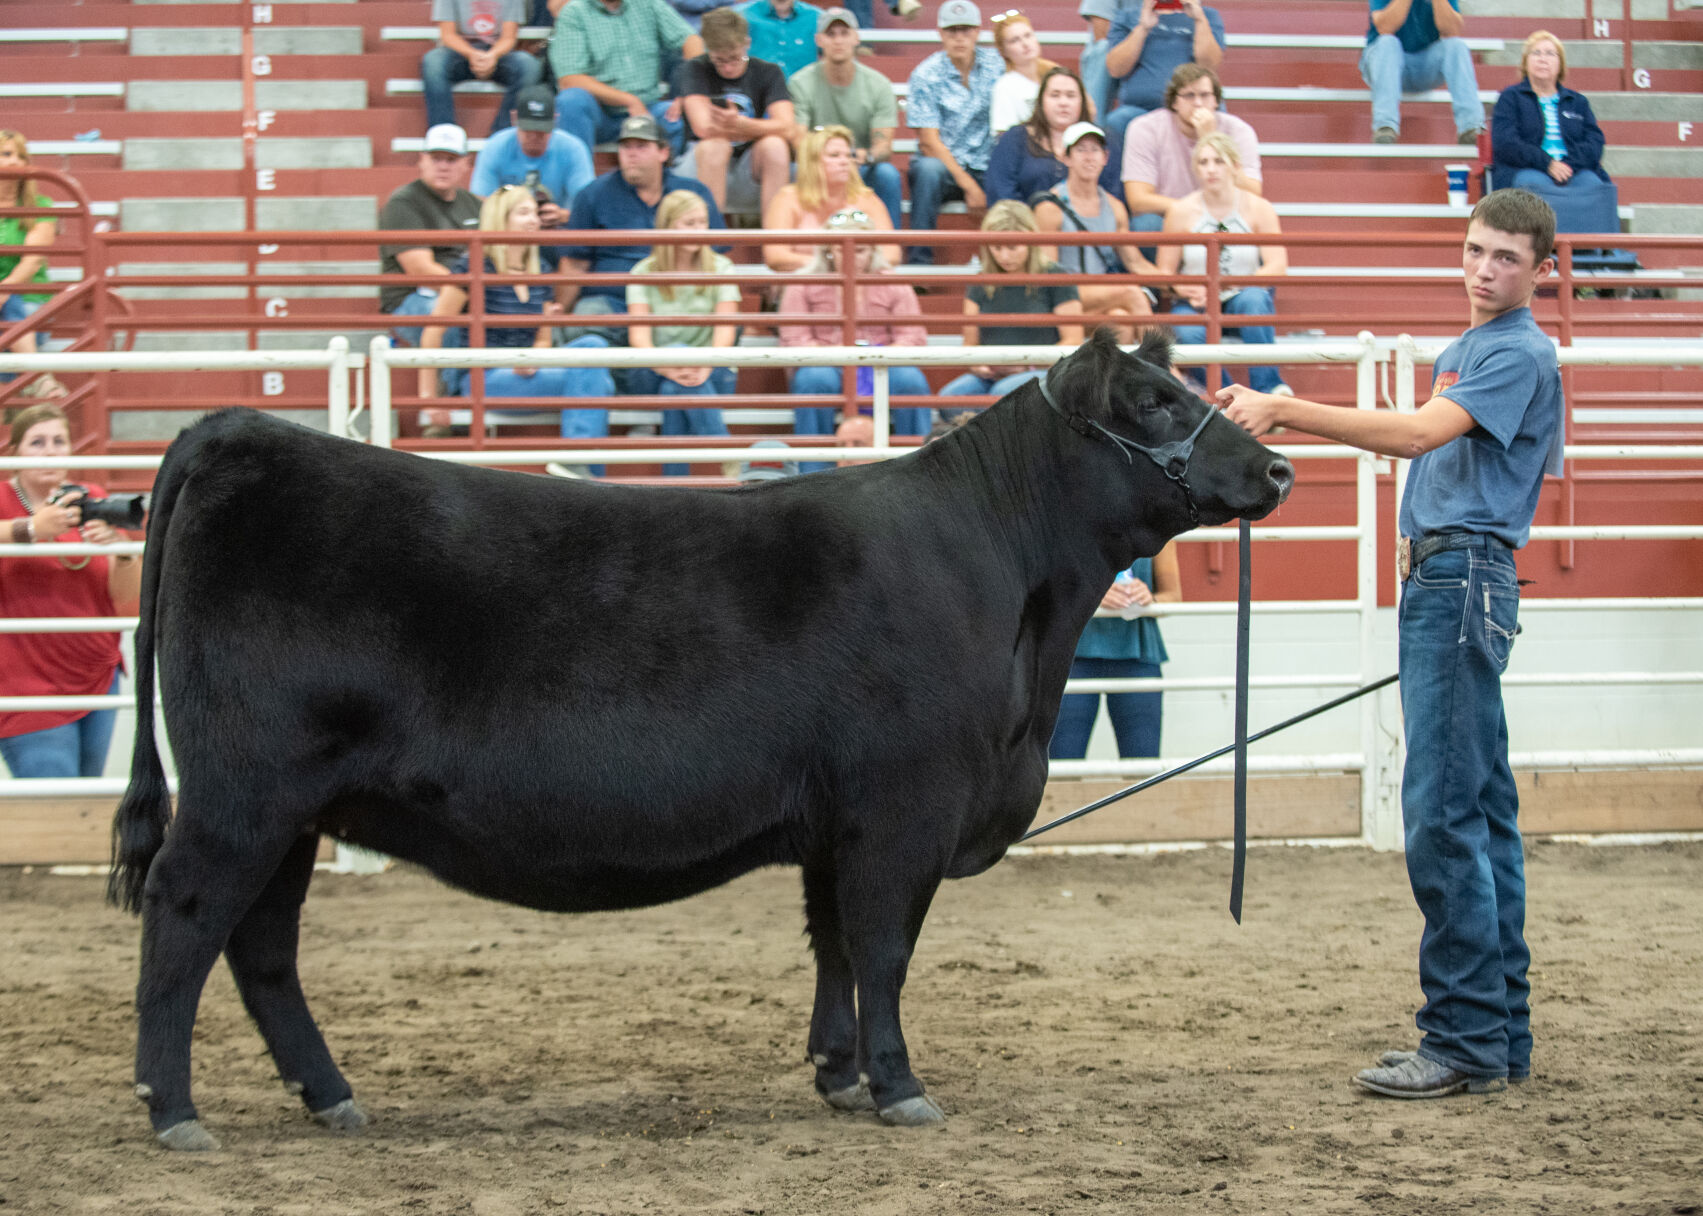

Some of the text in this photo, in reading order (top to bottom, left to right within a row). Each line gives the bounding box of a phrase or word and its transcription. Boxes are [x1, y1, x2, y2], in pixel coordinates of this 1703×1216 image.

[254, 4, 273, 23] H
[1593, 19, 1610, 37] H
[252, 55, 272, 76] G
[1633, 68, 1651, 88] G
[258, 110, 276, 131] F
[1678, 121, 1693, 141] F
[257, 169, 276, 190] E
[265, 298, 288, 317] C
[263, 372, 285, 395] B
